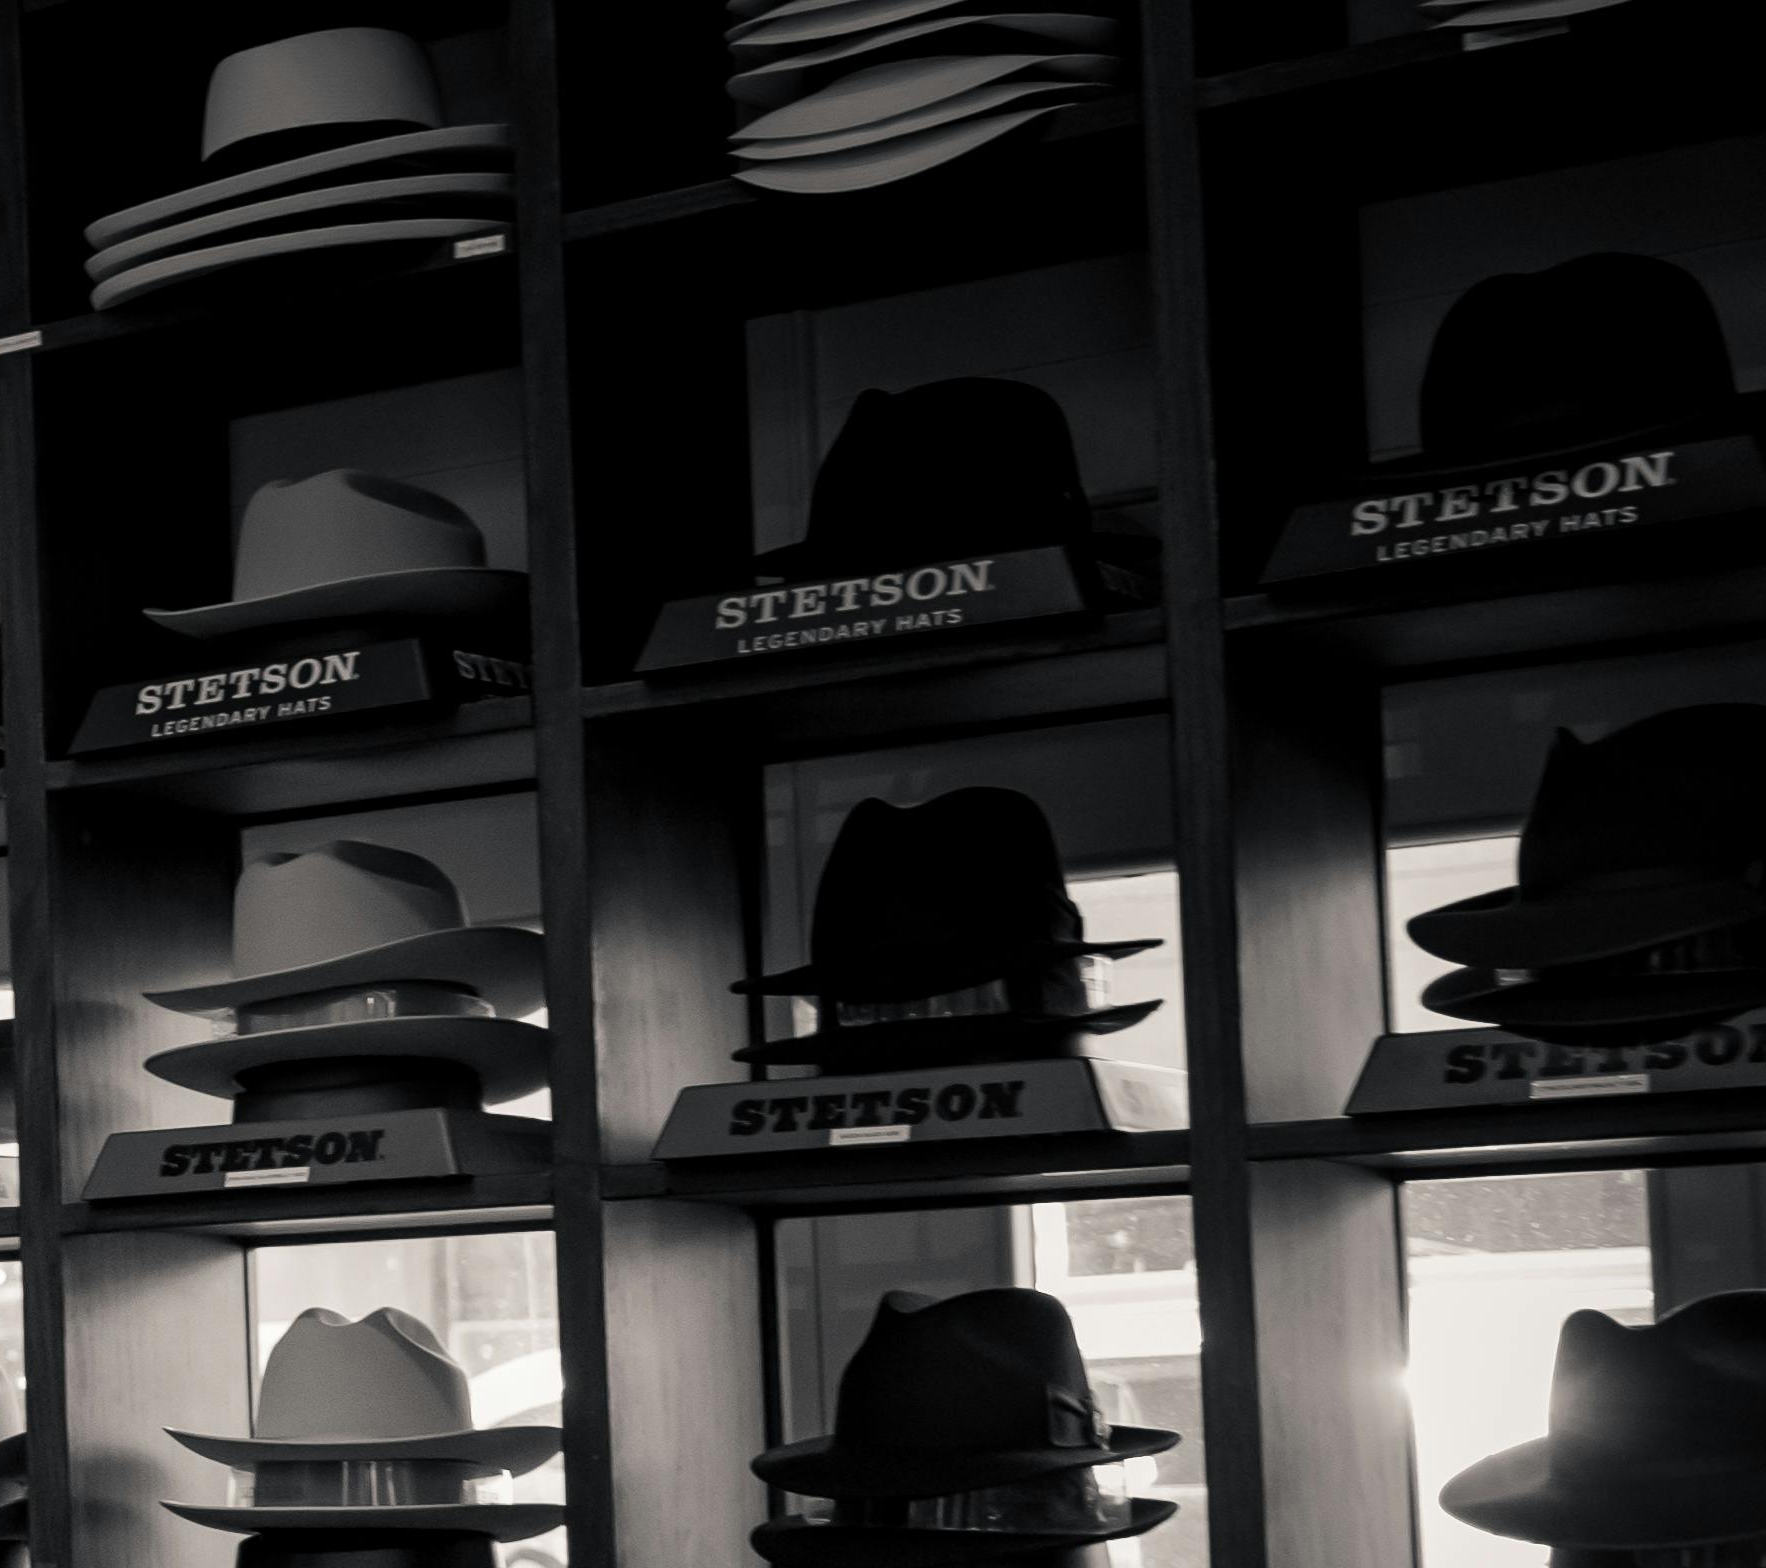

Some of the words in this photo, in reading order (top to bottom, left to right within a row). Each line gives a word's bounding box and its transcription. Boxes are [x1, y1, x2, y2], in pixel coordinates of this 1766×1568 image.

[1350, 451, 1676, 537] STETSON
[1375, 518, 1551, 562] LEGENDARY
[1558, 505, 1640, 533] HATS
[714, 560, 997, 630] STETSON
[736, 618, 888, 655] LEGENDARY
[895, 608, 964, 633] HATS
[134, 650, 362, 716] STETSON
[150, 704, 273, 738] LEGENDARY
[277, 695, 333, 719] HATS
[729, 1080, 1025, 1137] STETSON
[159, 1129, 386, 1178] STETSON
